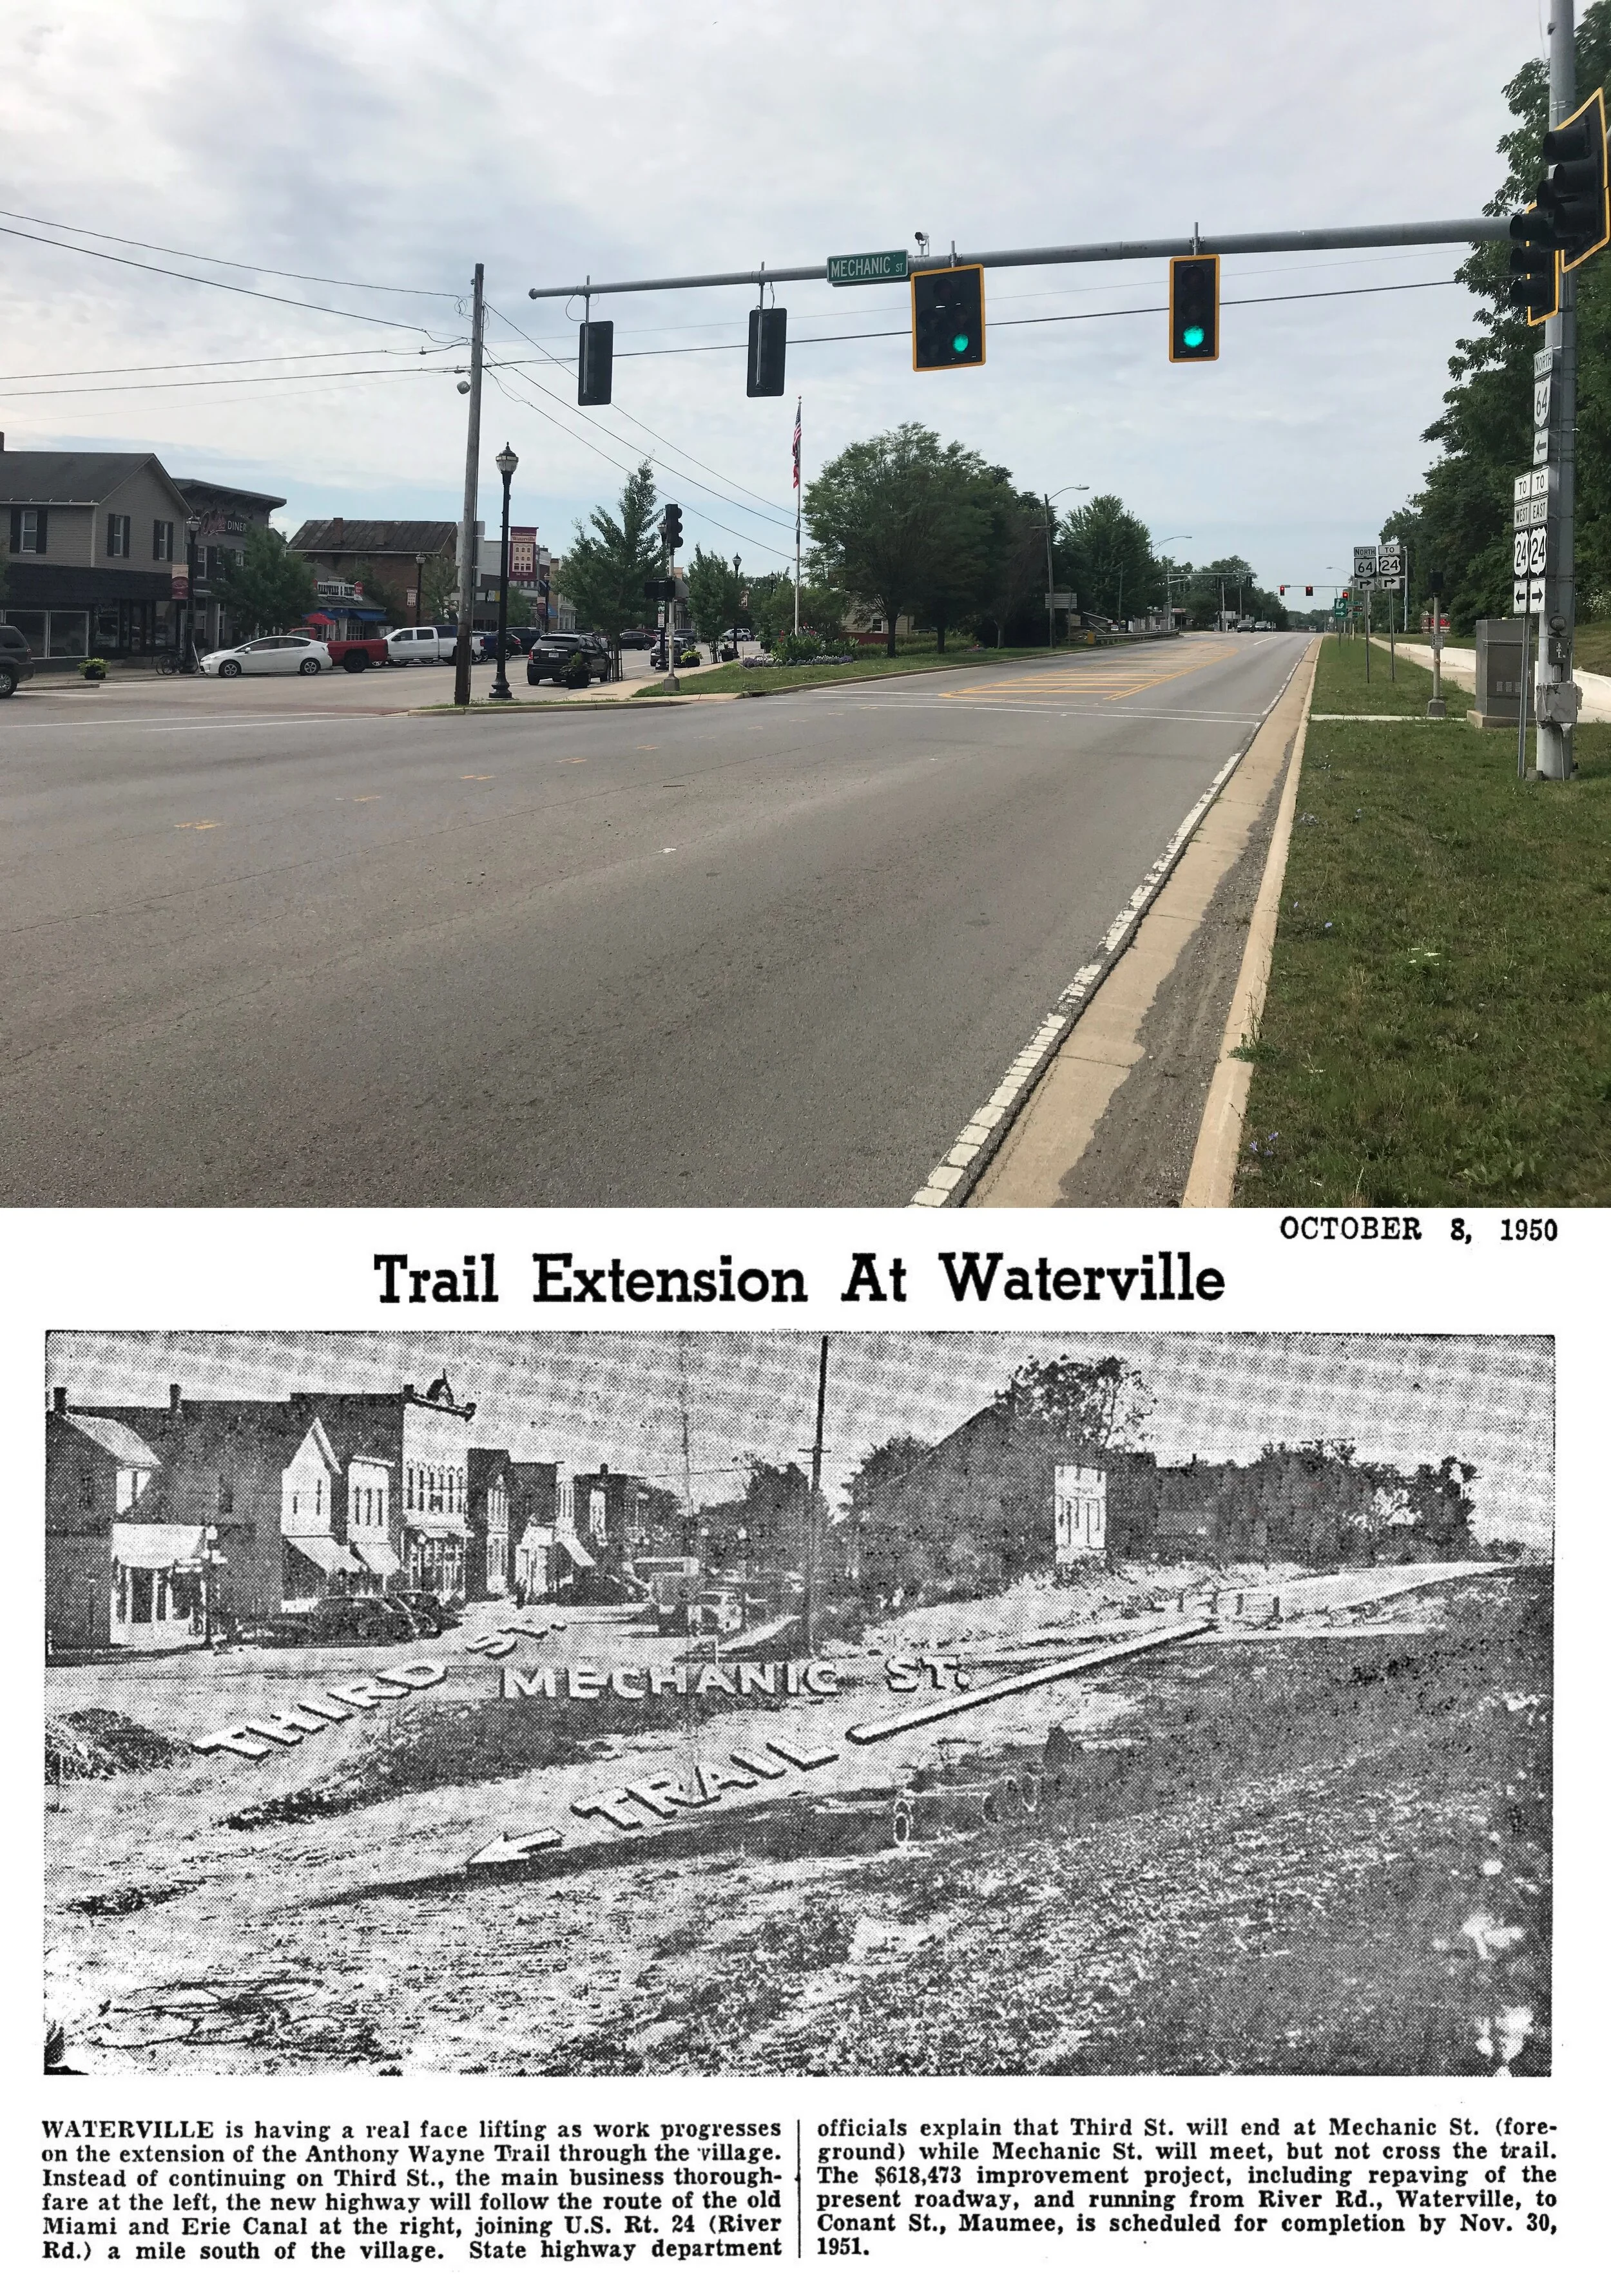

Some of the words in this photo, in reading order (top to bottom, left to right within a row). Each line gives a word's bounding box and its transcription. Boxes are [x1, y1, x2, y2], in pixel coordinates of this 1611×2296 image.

[831, 256, 891, 278] MECHANIC
[896, 263, 903, 273] ST
[1535, 352, 1552, 372] NORTH
[1536, 387, 1548, 417] 64
[1519, 480, 1527, 495] TO
[1536, 474, 1545, 490] TO
[1516, 507, 1528, 523] WEST
[1533, 502, 1546, 519] EAST
[227, 520, 247, 533] DINER
[1516, 539, 1527, 567] 24
[1532, 535, 1545, 565] 24
[1358, 562, 1373, 573] 64
[1382, 559, 1398, 571] 24
[1280, 1216, 1422, 1240] OCTOBER
[1451, 1218, 1471, 1244] 8,
[1501, 1219, 1558, 1241] 1950
[374, 1253, 498, 1303] Trail
[532, 1253, 808, 1302] Extension
[841, 1253, 907, 1302] At
[938, 1251, 1225, 1301] Waterville
[499, 1661, 842, 1699] MECHANIC
[885, 1653, 969, 1692] ST.
[193, 1658, 448, 1760] THIRD
[570, 1737, 839, 1830] TRAIL
[42, 2121, 213, 2138] WATERVILLE
[226, 2121, 243, 2138] is
[255, 2121, 331, 2142] having
[342, 2126, 354, 2138] a
[366, 2121, 409, 2138] real
[421, 2120, 467, 2138] face
[480, 2120, 546, 2141] lifting
[558, 2125, 581, 2137] as
[593, 2122, 650, 2138] work
[661, 2123, 780, 2140] progresses
[818, 2118, 907, 2136] officials
[921, 2118, 1001, 2139] explain
[1014, 2118, 1058, 2136] that
[1070, 2118, 1132, 2136] Third
[1144, 2118, 1173, 2136] St.
[1187, 2118, 1228, 2135] will
[1242, 2118, 1280, 2135] end
[1294, 2119, 1316, 2135] at
[1329, 2118, 1436, 2135] Mechanic
[1450, 2118, 1478, 2135] St.
[1496, 2117, 1557, 2136] (fore-
[42, 2150, 67, 2161] on
[77, 2145, 110, 2162] the
[120, 2145, 224, 2162] extension
[233, 2145, 254, 2162] of
[262, 2145, 296, 2162] the
[305, 2145, 399, 2165] Anthony
[409, 2146, 484, 2165] Wayne
[494, 2144, 550, 2161] Trail
[559, 2144, 647, 2165] through
[655, 2144, 689, 2161] the
[698, 2143, 780, 2164] village.
[818, 2143, 905, 2163] ground)
[920, 2142, 978, 2159] while
[993, 2142, 1100, 2159] Mechanic
[1114, 2143, 1142, 2160] St.
[1155, 2142, 1197, 2159] will
[1210, 2143, 1273, 2162] meet,
[1287, 2142, 1322, 2159] but
[1335, 2142, 1370, 2159] not
[1383, 2146, 1440, 2159] cross
[1453, 2142, 1487, 2159] the
[1500, 2141, 1556, 2159] trail.
[43, 2169, 126, 2186] Instead
[137, 2169, 158, 2186] of
[169, 2168, 285, 2190] continuing
[297, 2174, 323, 2186] on
[334, 2169, 396, 2186] Third
[407, 2169, 443, 2188] St.,
[456, 2169, 489, 2186] the
[501, 2168, 558, 2185] main
[570, 2168, 664, 2185] business
[674, 2167, 782, 2188] thorough-
[817, 2166, 858, 2183] The
[876, 2166, 961, 2186] $618,473
[977, 2166, 1128, 2187] improvement
[1144, 2166, 1231, 2187] project,
[1248, 2166, 1352, 2187] including
[1369, 2166, 1468, 2187] repaving
[1485, 2165, 1506, 2183] of
[1522, 2165, 1556, 2183] the
[43, 2193, 88, 2210] fare
[99, 2194, 120, 2210] at
[129, 2194, 163, 2210] the
[173, 2193, 217, 2213] left,
[226, 2193, 260, 2211] the
[271, 2198, 316, 2210] new
[325, 2193, 420, 2214] highway
[430, 2192, 470, 2210] will
[480, 2193, 549, 2210] follow
[557, 2192, 592, 2209] the
[603, 2192, 661, 2210] route
[672, 2191, 693, 2208] of
[702, 2191, 737, 2208] the
[748, 2190, 780, 2208] old
[816, 2190, 901, 2211] present
[915, 2190, 1019, 2210] roadway,
[1034, 2190, 1074, 2207] and
[1089, 2190, 1175, 2211] running
[1190, 2190, 1244, 2207] from
[1259, 2190, 1322, 2207] River
[1336, 2190, 1382, 2210] Rd.,
[1396, 2189, 1521, 2210] Waterville,
[1536, 2190, 1556, 2207] to
[43, 2217, 117, 2235] Miami
[129, 2218, 169, 2235] and
[182, 2217, 230, 2235] Erie
[244, 2217, 307, 2235] Canal
[320, 2217, 342, 2234] at
[353, 2217, 387, 2235] the
[400, 2217, 461, 2238] right,
[475, 2216, 552, 2237] joining
[564, 2216, 610, 2234] U.S.
[624, 2215, 659, 2233] Rt.
[672, 2215, 695, 2232] 24
[709, 2214, 782, 2234] (River
[818, 2214, 896, 2231] Conant
[909, 2214, 946, 2235] St.,
[959, 2214, 1063, 2235] Maumee,
[1077, 2214, 1095, 2231] is
[1110, 2214, 1220, 2232] scheduled
[1235, 2214, 1268, 2231] for
[1282, 2214, 1405, 2235] completion
[1419, 2214, 1446, 2235] by
[1460, 2214, 1512, 2231] Nov.
[1527, 2213, 1556, 2235] 30,
[43, 2241, 91, 2261] Rd.)
[108, 2246, 120, 2259] a
[136, 2242, 185, 2259] mile
[200, 2242, 260, 2259] south
[275, 2242, 296, 2259] of
[311, 2242, 345, 2259] the
[360, 2241, 443, 2262] village.
[470, 2241, 526, 2259] State
[541, 2240, 636, 2261] highway
[652, 2238, 782, 2261] department
[818, 2237, 869, 2255] 1951.
